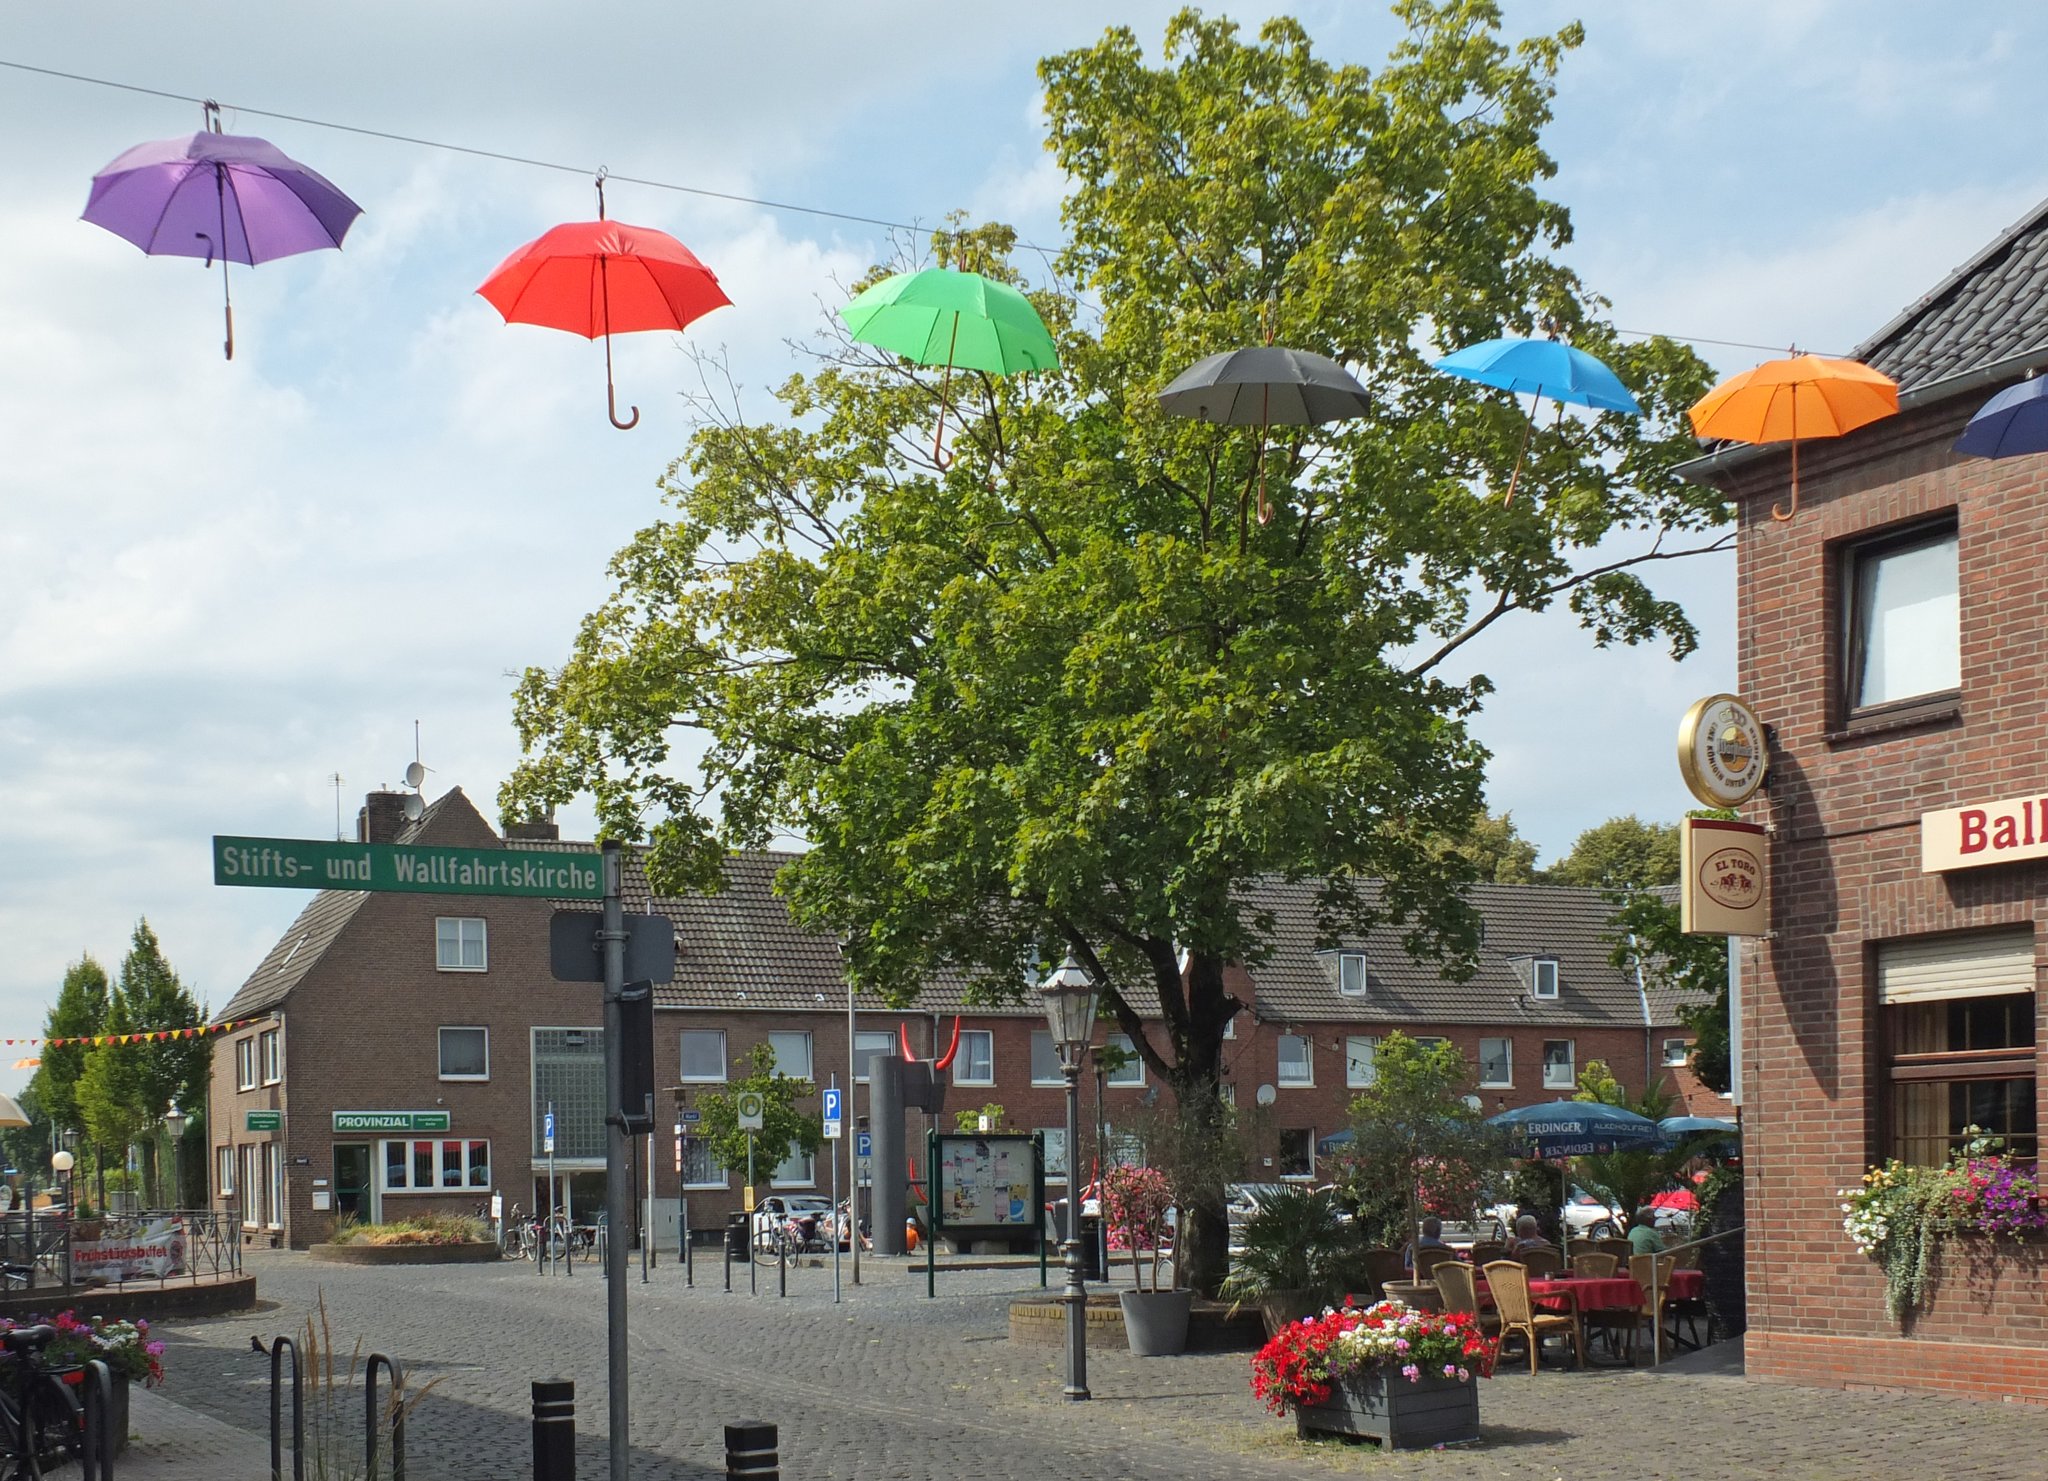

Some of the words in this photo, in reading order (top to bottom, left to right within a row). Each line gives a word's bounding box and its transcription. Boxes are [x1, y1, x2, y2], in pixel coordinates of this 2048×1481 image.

[223, 846, 313, 878] Stifts-
[326, 853, 371, 880] und
[394, 854, 596, 889] Wallfahrtskirche
[1715, 860, 1729, 871] EL
[1731, 859, 1755, 875] TORO
[826, 1093, 836, 1116] P
[338, 1116, 409, 1127] PROVINZIAL
[1528, 1122, 1582, 1134] ERDINGER
[860, 1136, 871, 1154] P
